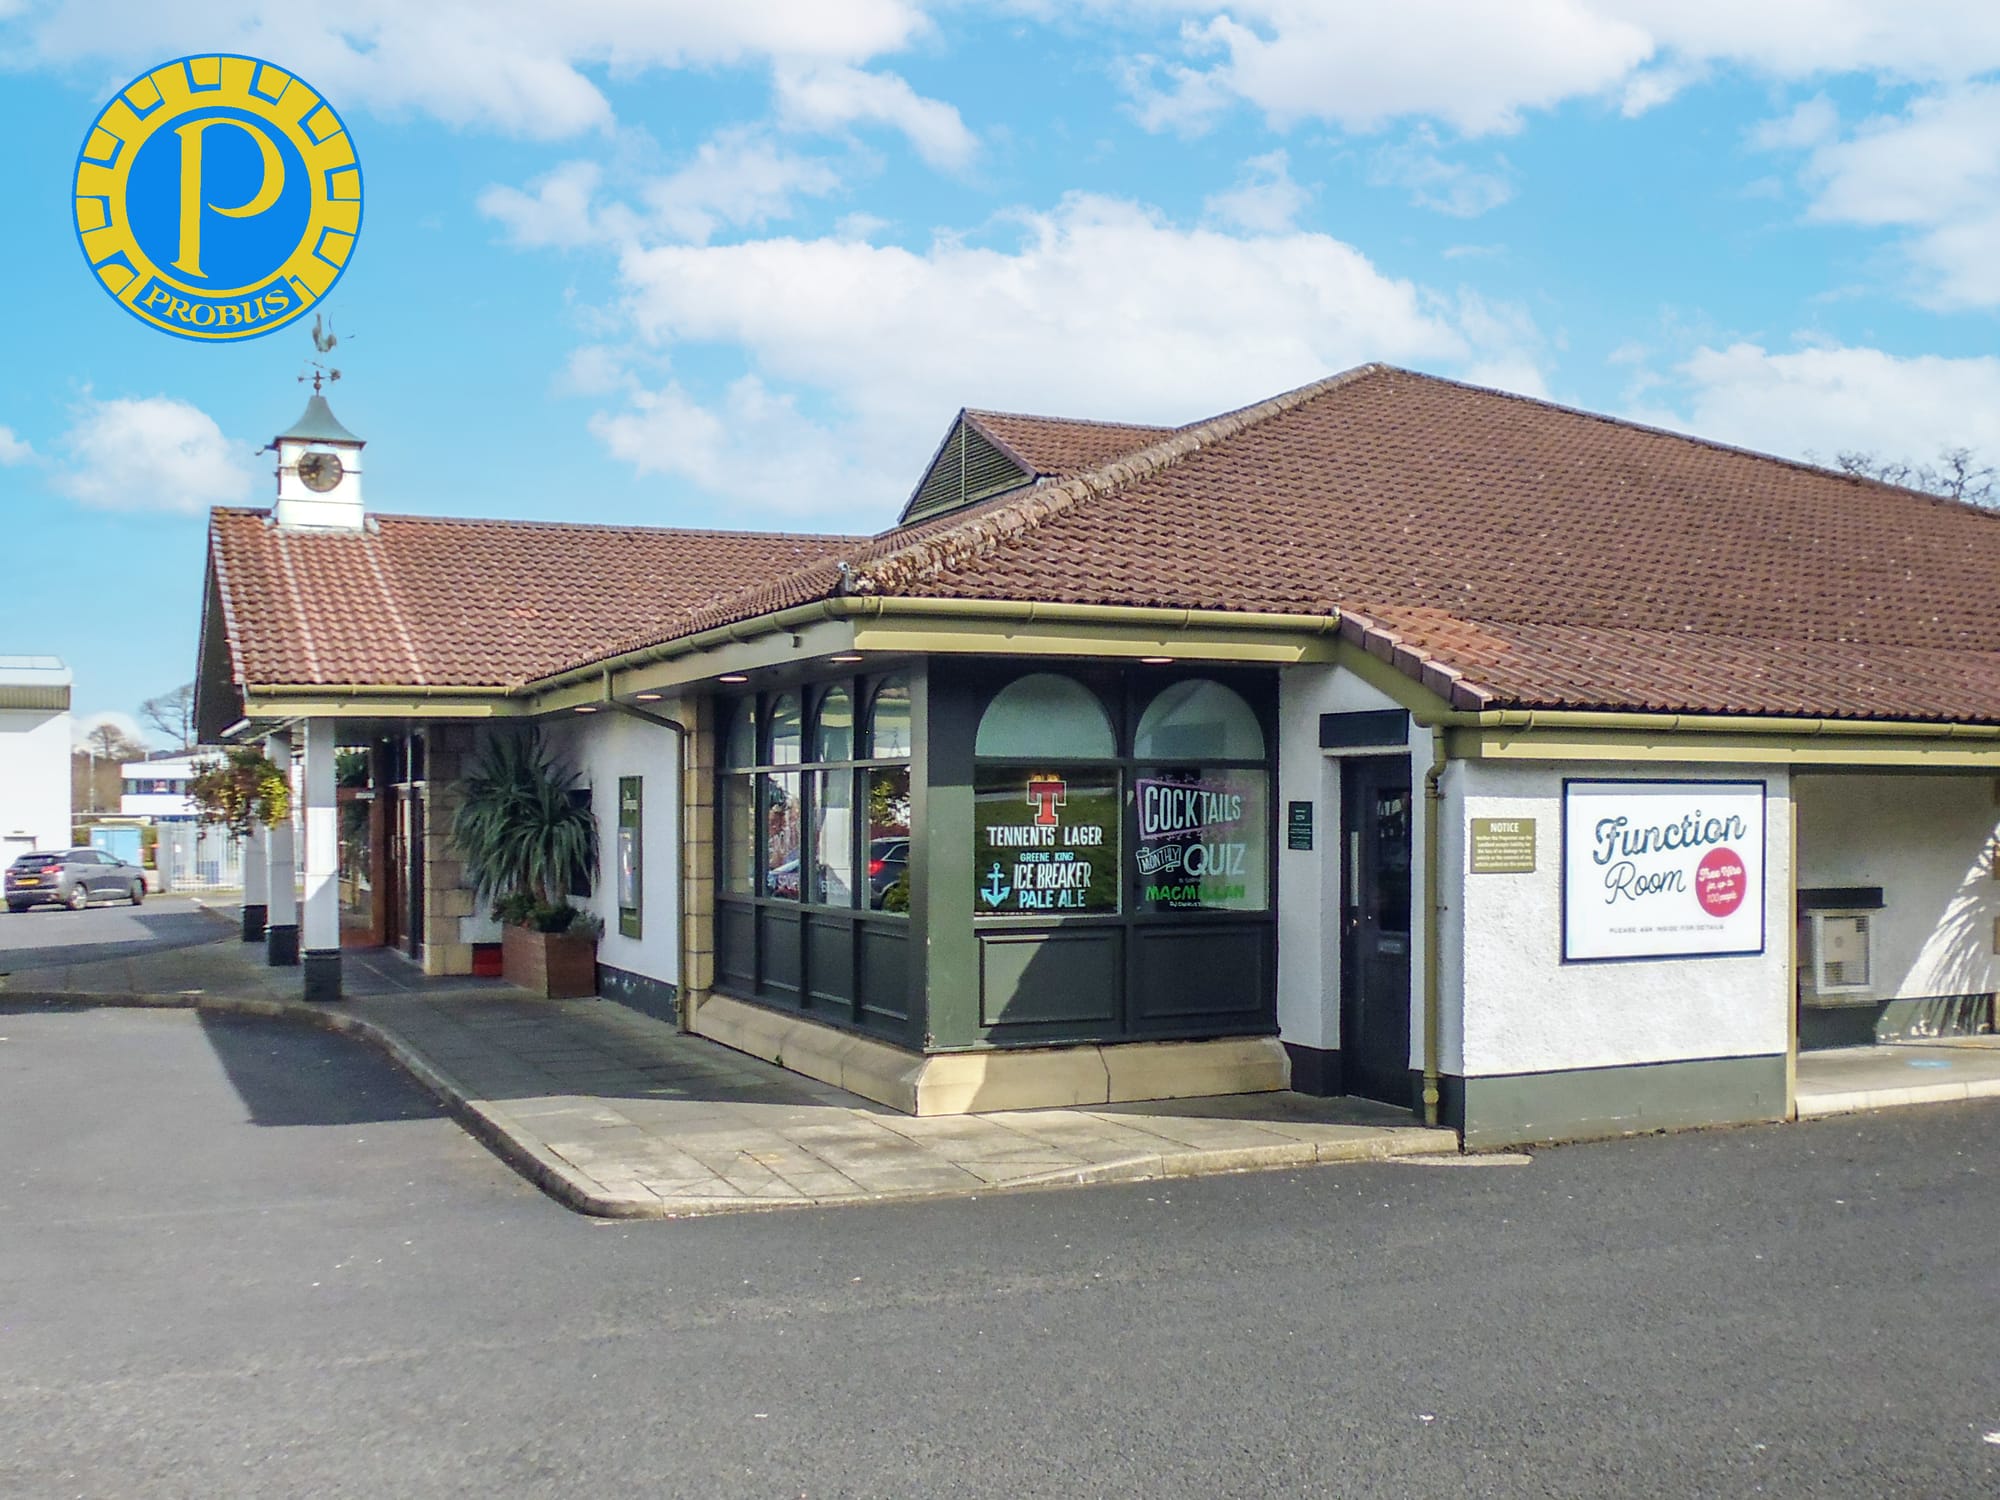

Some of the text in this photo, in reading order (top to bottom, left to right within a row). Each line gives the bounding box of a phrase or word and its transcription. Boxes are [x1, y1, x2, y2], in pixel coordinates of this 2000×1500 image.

[1144, 786, 1242, 833] COCKTAILS
[986, 826, 1103, 847] TENNENTS LAGER
[1490, 822, 1519, 833] NOTICE
[1593, 810, 1746, 865] Function
[1020, 851, 1075, 863] GREENE KING
[1140, 843, 1247, 876] MONTHLY QUIZ
[1013, 861, 1092, 890] ICE BREAKER
[1605, 861, 1686, 905] Room
[1019, 889, 1086, 909] PALE ALE
